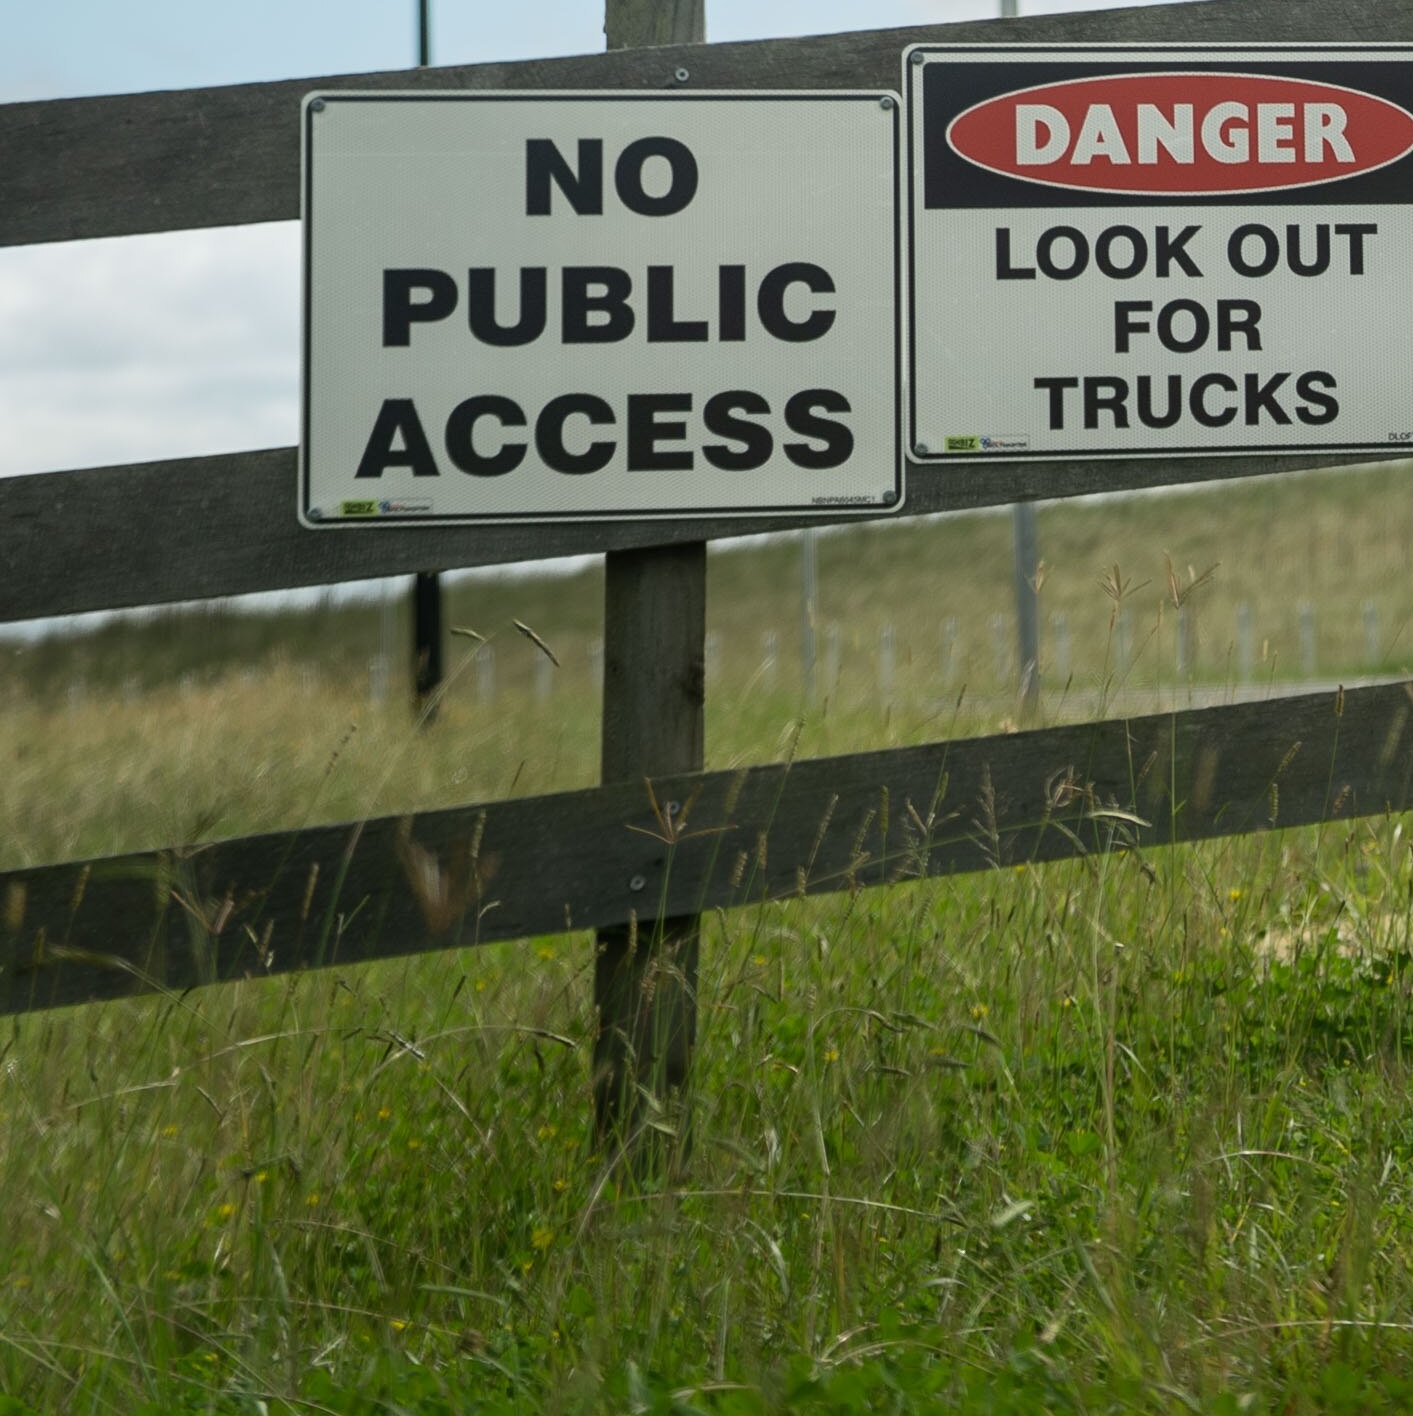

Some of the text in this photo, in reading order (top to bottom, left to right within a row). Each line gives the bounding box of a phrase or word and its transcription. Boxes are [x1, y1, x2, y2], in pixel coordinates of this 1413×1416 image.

[1015, 101, 1356, 166] DANGER
[525, 136, 698, 216] NO
[996, 224, 1377, 280] LOOK OUT
[382, 262, 836, 347] PUBLIC
[1114, 299, 1262, 353] FOR
[1034, 371, 1340, 431] TRUCKS
[354, 389, 854, 479] ACCESS
